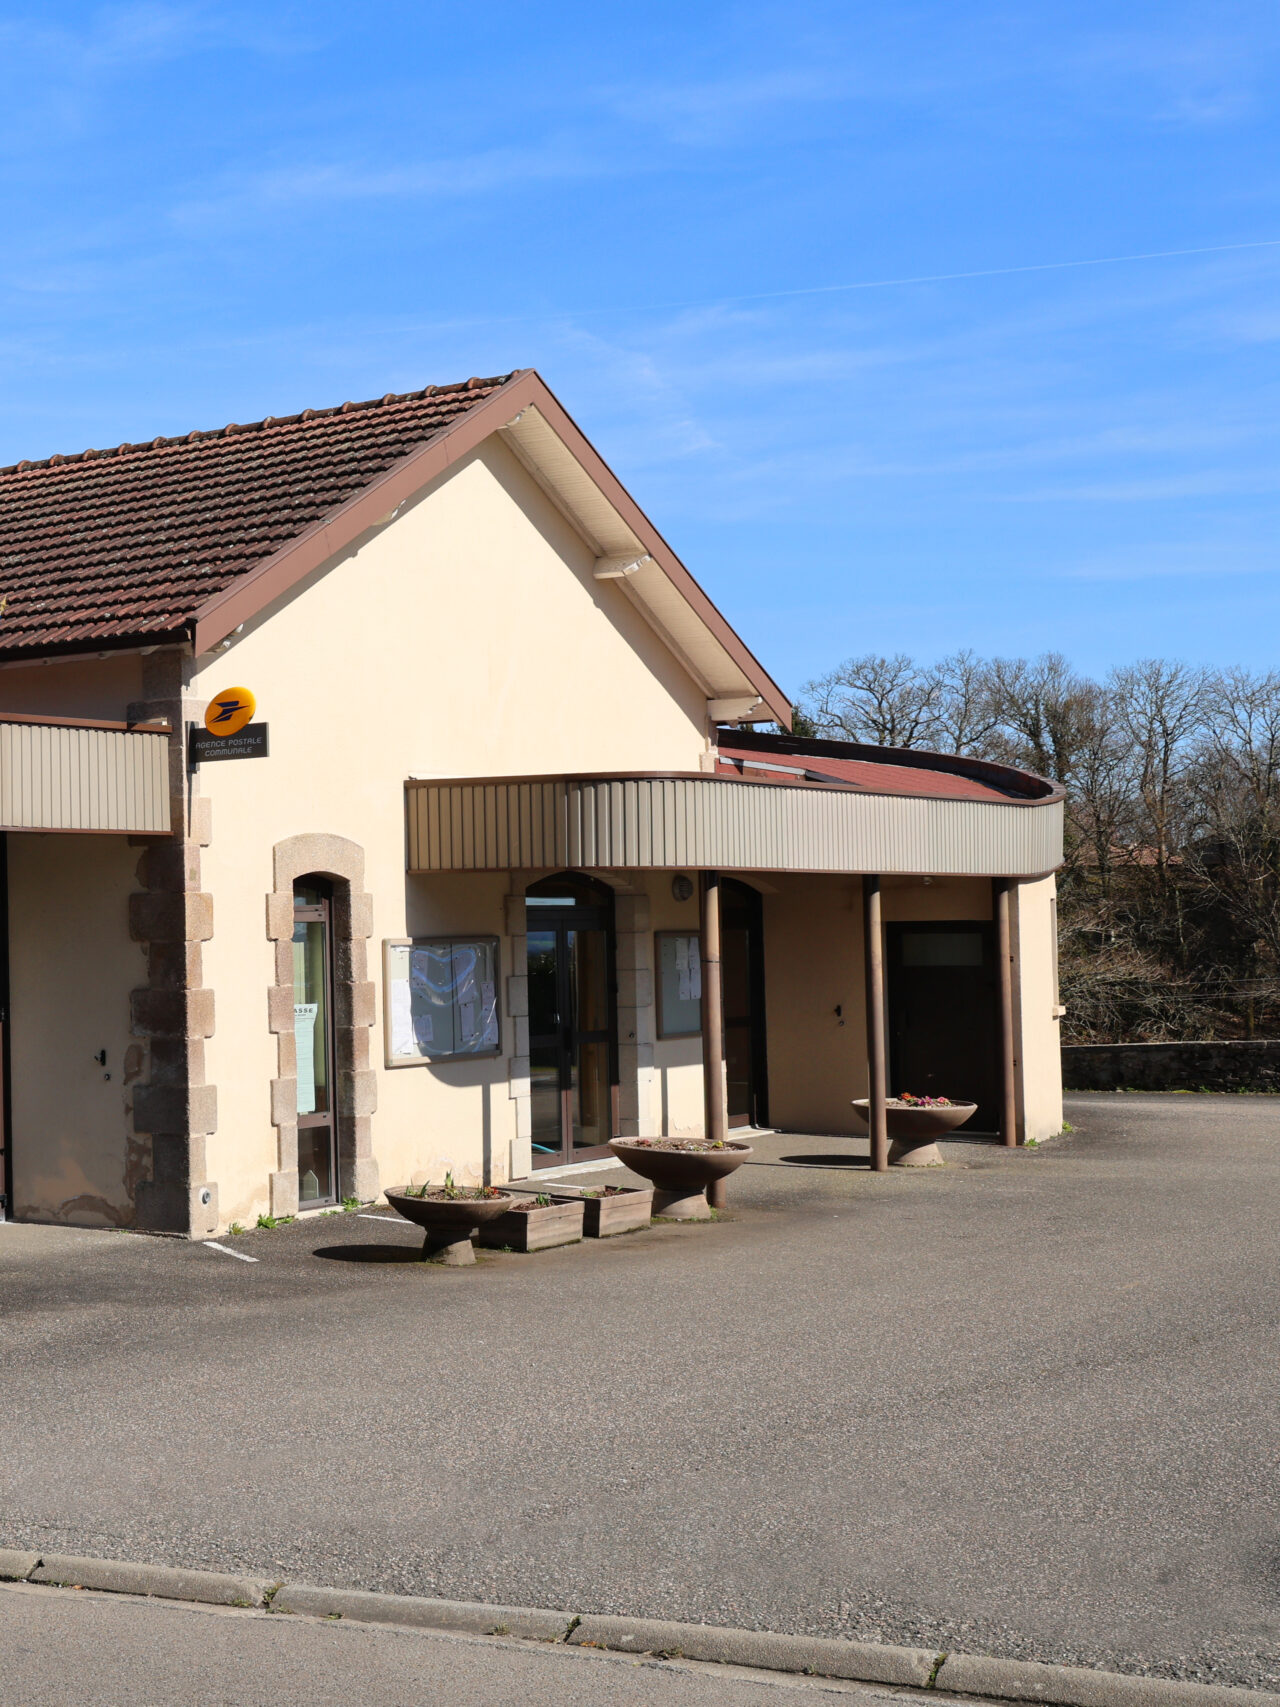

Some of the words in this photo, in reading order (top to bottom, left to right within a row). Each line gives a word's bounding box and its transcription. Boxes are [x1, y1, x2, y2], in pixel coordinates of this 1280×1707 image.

[195, 740, 226, 749] AGENCE
[228, 737, 263, 746] POSTALE
[204, 747, 253, 757] COMMUNALE
